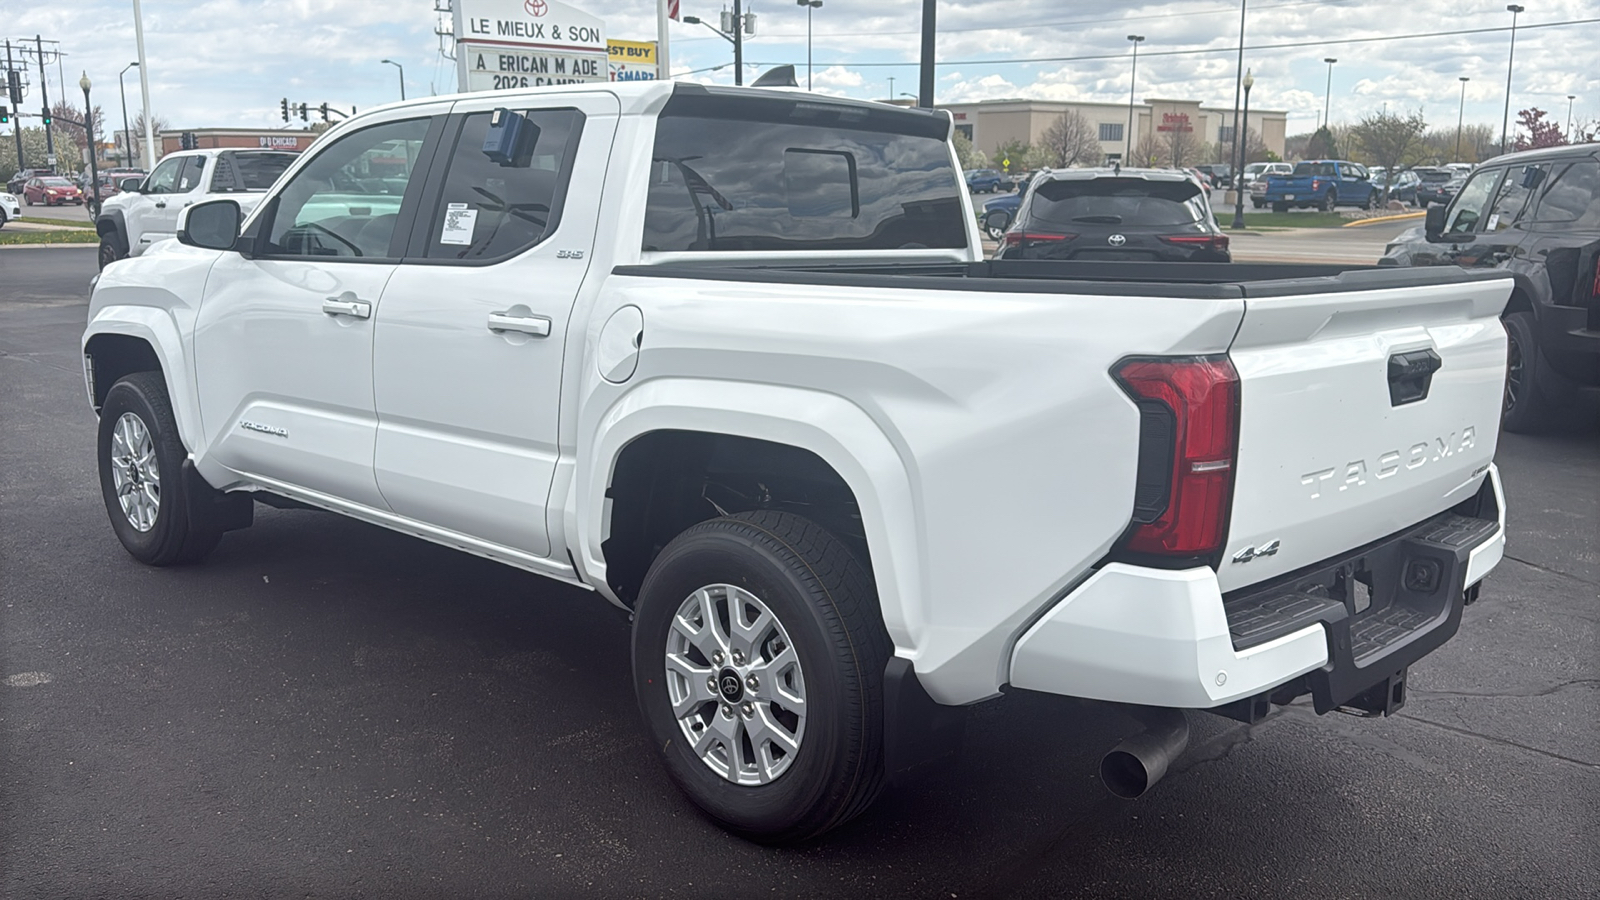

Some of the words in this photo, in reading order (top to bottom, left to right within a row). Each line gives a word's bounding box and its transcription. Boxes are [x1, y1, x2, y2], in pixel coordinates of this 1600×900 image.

[470, 17, 491, 34] LE
[497, 20, 545, 38] MIEUX
[551, 24, 562, 40] &
[568, 26, 600, 43] SON
[607, 45, 625, 56] EST
[627, 47, 651, 58] BUY
[493, 74, 529, 90] 2026
[272, 136, 297, 147] CHICAGO
[556, 249, 584, 260] SR5
[240, 420, 289, 439] TACOMA
[1300, 425, 1476, 499] TACOMA
